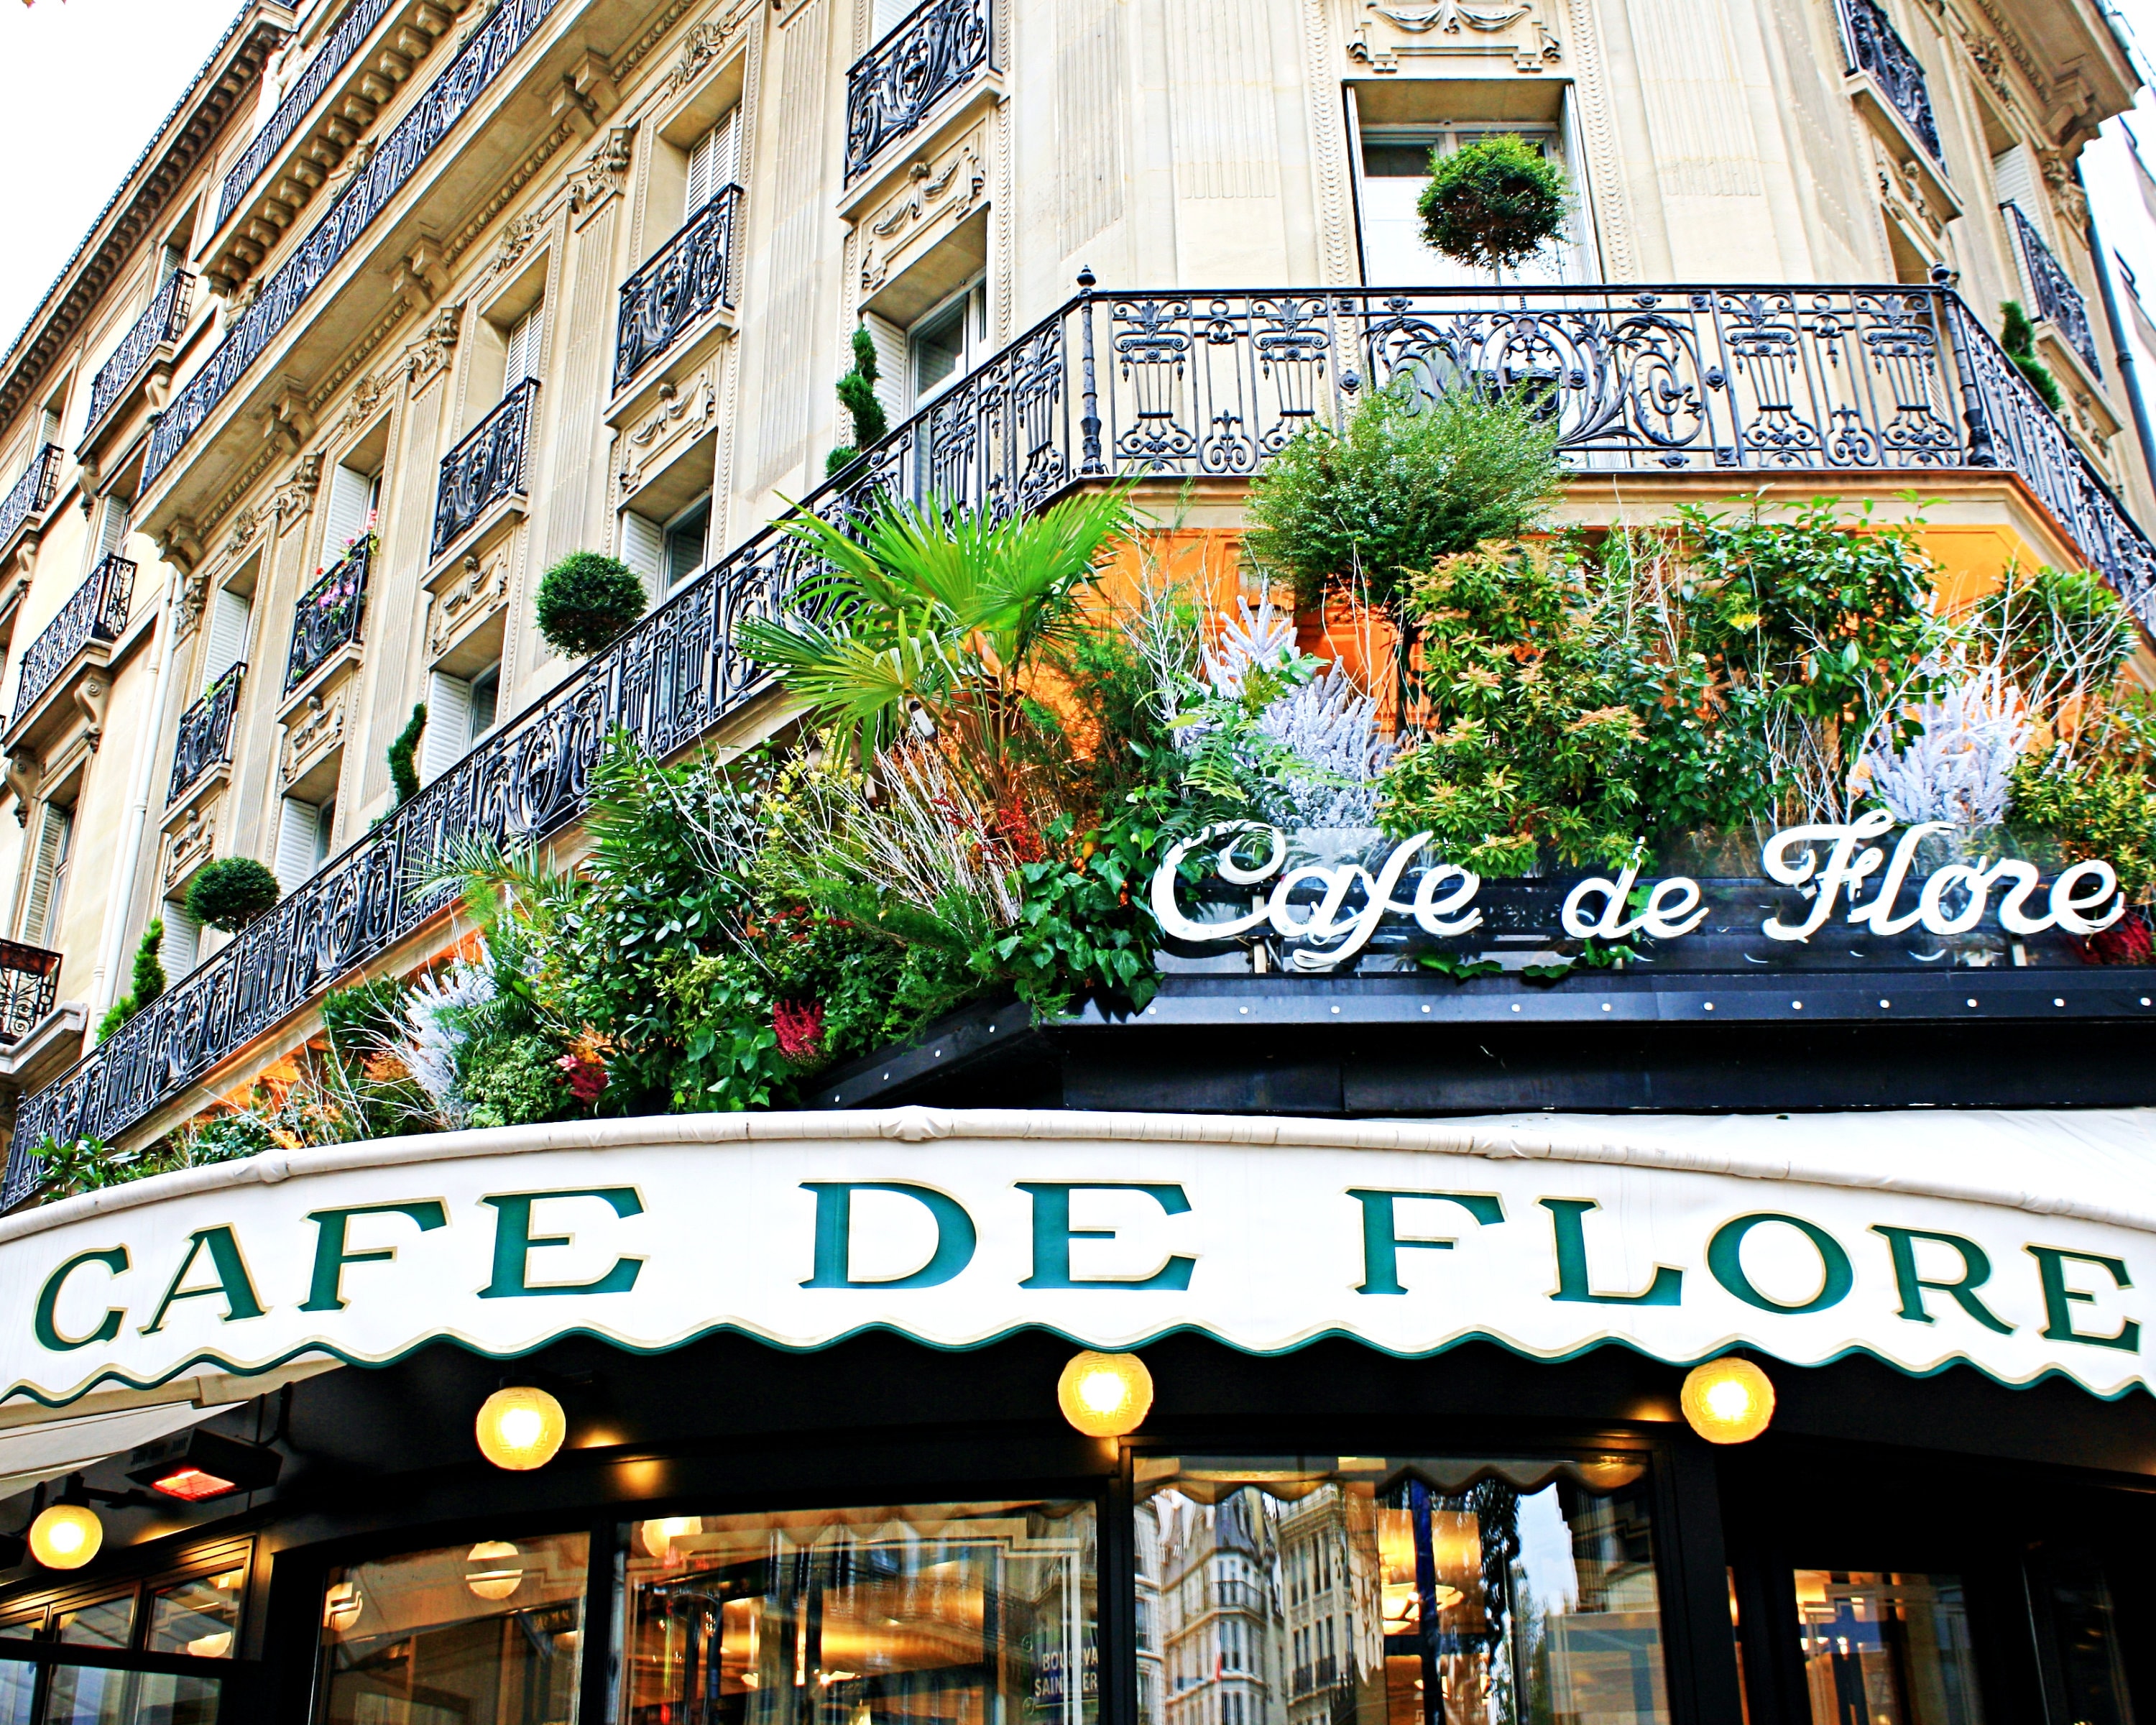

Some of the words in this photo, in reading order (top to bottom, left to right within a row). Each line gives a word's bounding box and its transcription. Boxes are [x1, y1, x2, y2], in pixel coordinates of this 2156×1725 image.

[1561, 836, 1710, 939] de
[1761, 809, 2126, 943] Flore
[34, 1184, 648, 1352] CAFE
[798, 1179, 1202, 1291] DE
[1345, 1187, 2142, 1354] FLORE
